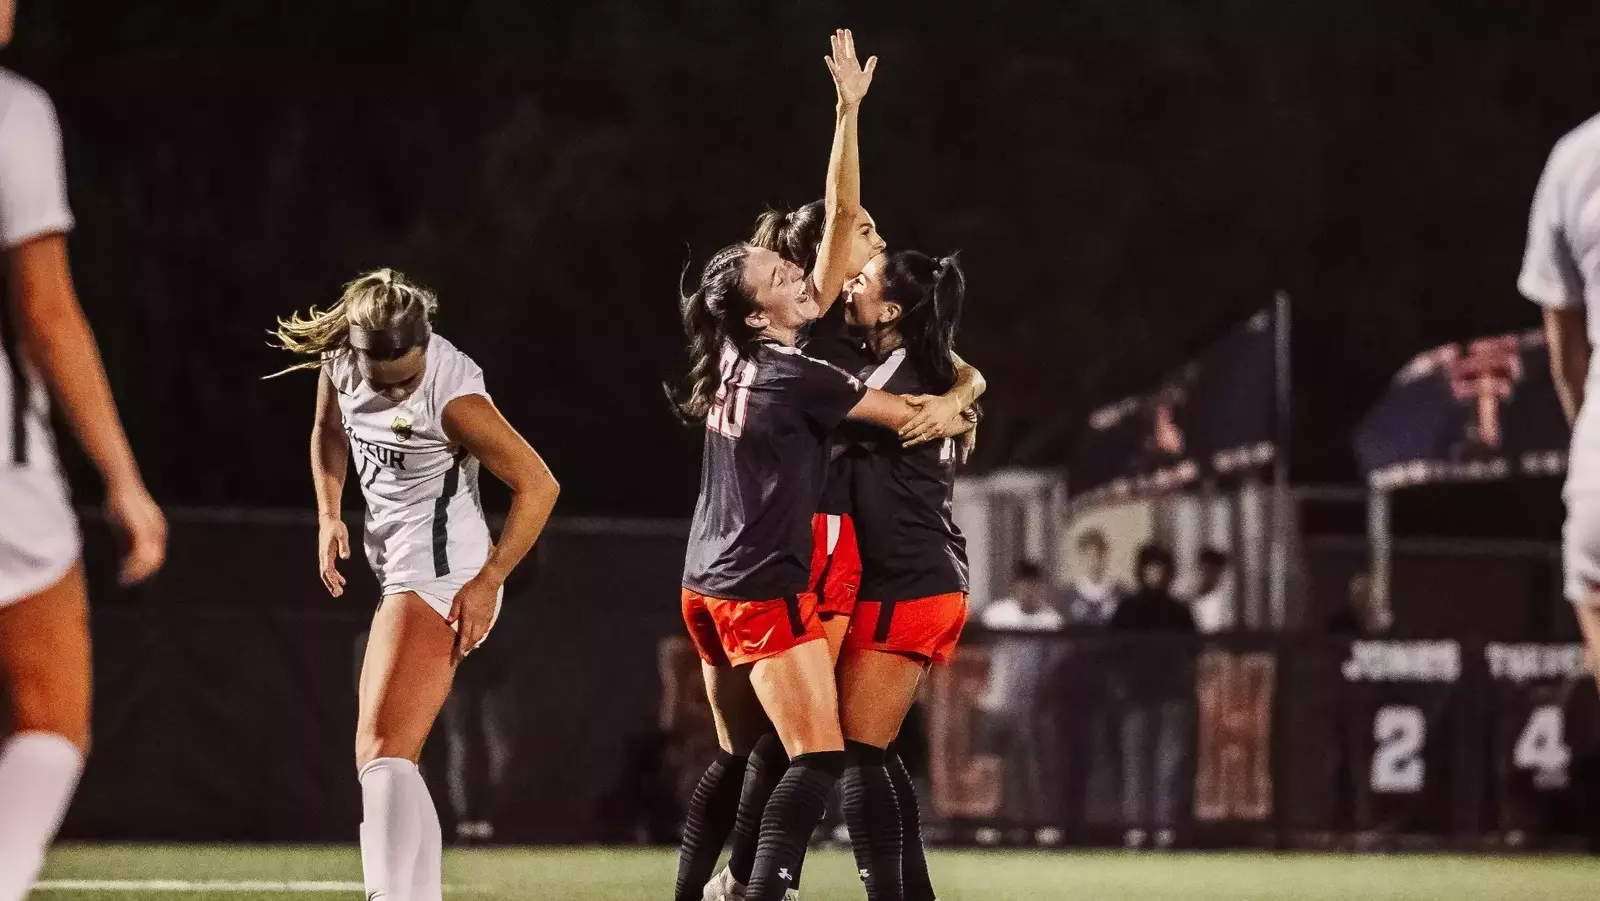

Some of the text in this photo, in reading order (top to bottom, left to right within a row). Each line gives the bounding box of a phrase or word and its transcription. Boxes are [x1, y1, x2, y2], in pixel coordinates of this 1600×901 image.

[706, 340, 758, 440] 20
[1370, 704, 1427, 793] 2
[1512, 704, 1572, 790] 4
